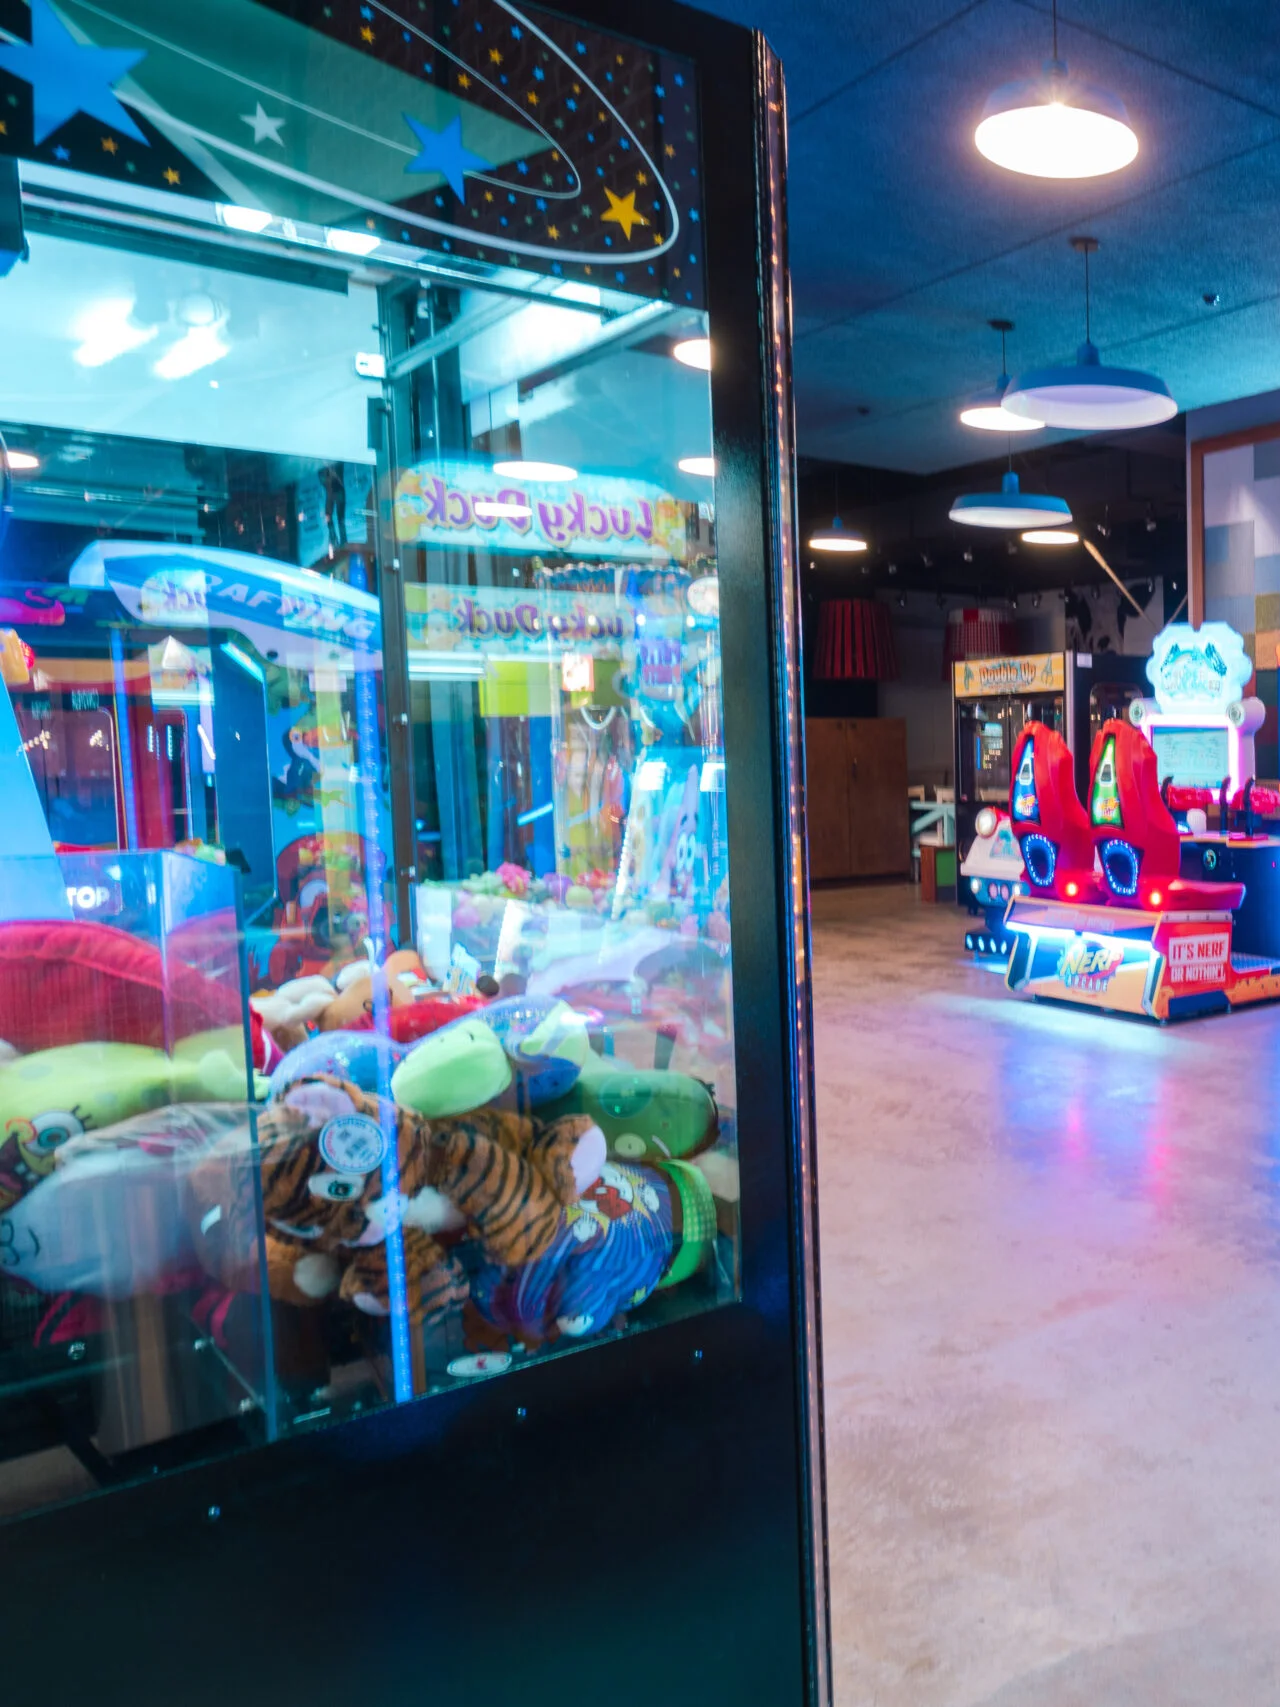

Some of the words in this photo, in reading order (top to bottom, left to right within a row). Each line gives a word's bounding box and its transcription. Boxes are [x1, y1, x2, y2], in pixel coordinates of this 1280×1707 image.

[979, 662, 1018, 685] Double
[1020, 661, 1036, 685] Up
[1060, 942, 1121, 975] NERF
[1172, 943, 1194, 960] IT'S
[1196, 940, 1225, 959] NERF
[1066, 973, 1108, 992] ARCADE
[1171, 966, 1184, 983] OR
